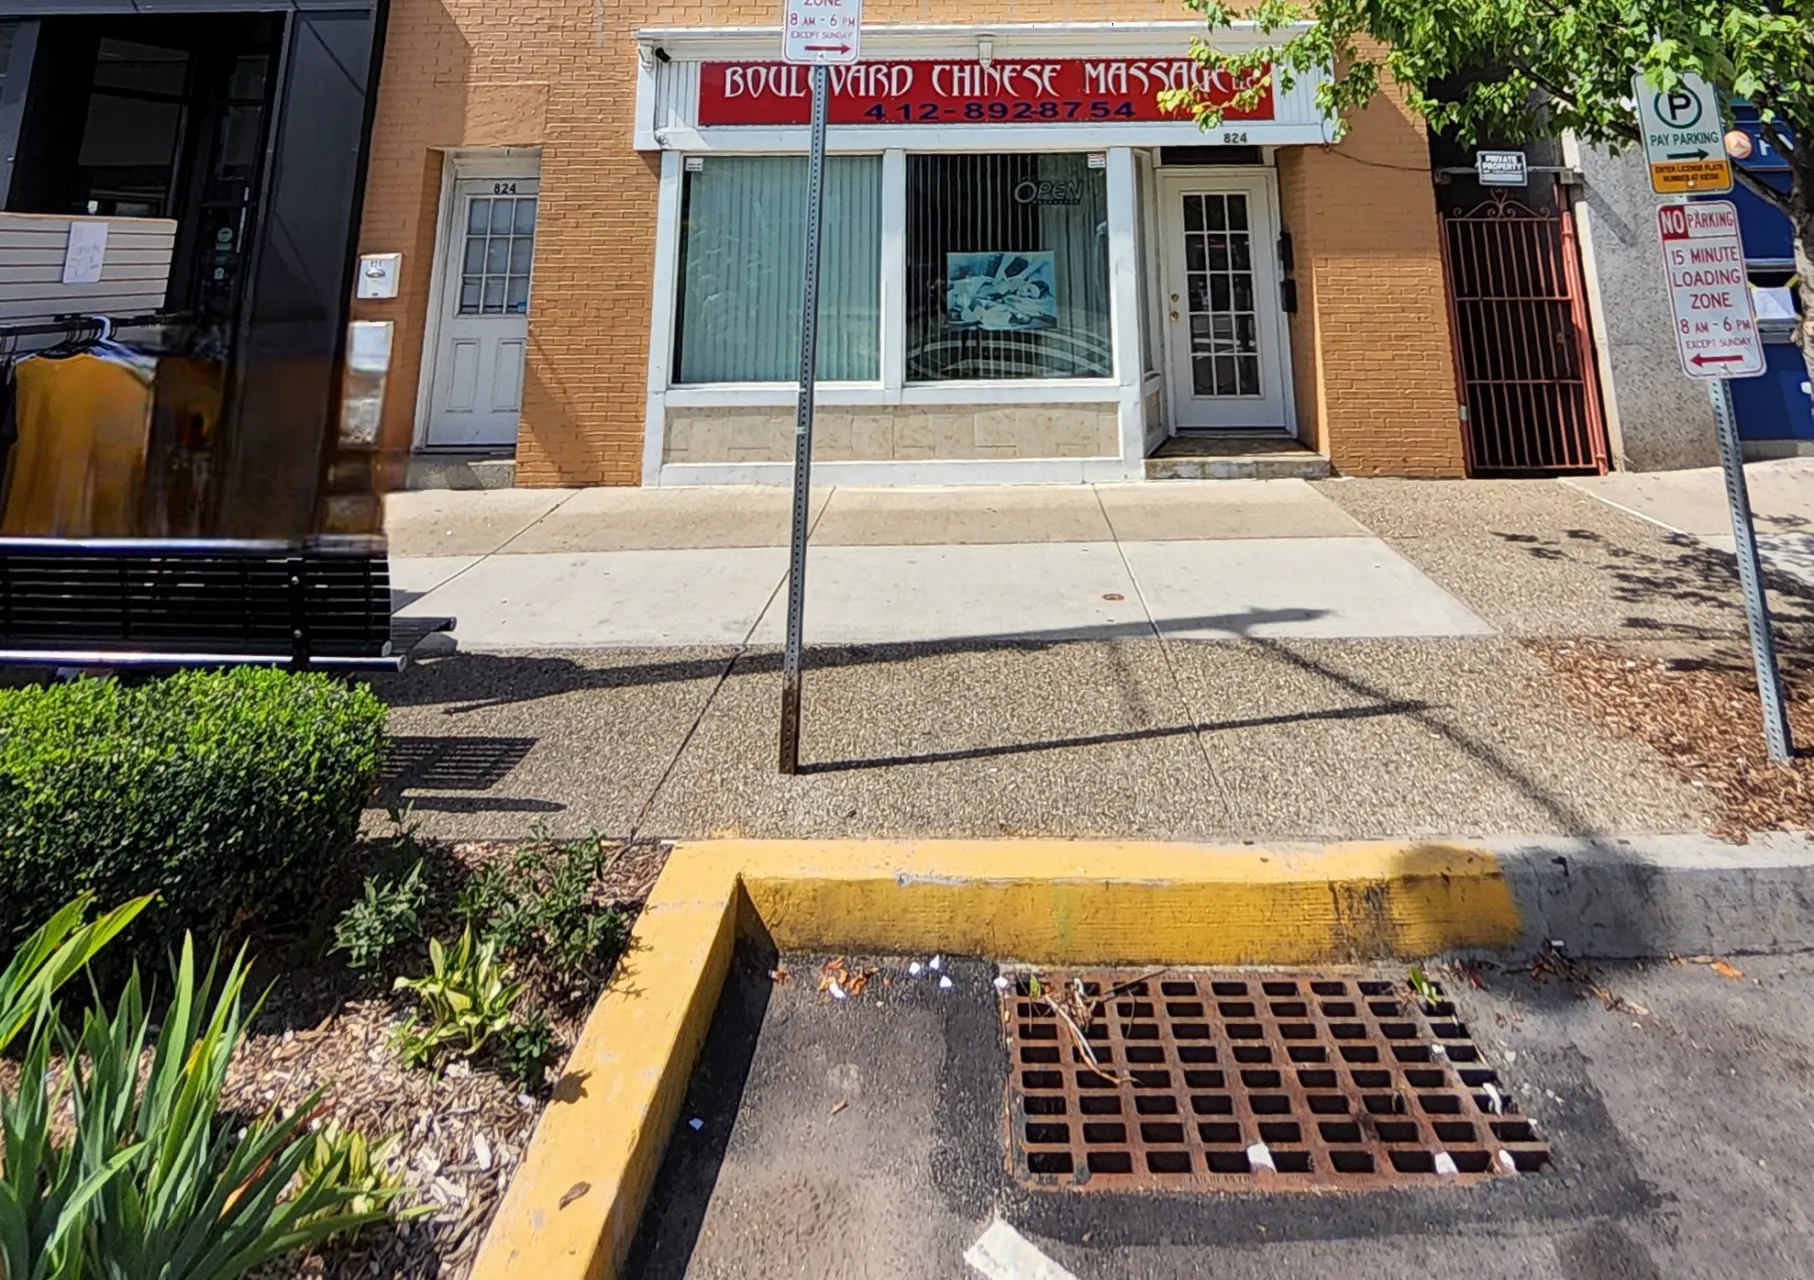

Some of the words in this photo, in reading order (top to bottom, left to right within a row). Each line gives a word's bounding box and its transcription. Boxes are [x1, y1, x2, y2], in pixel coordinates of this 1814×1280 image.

[790, 12, 798, 26] 8
[802, 16, 816, 25] AM
[830, 14, 837, 27] 6
[842, 17, 855, 26] PM
[791, 31, 819, 39] EXCEPT
[822, 31, 852, 39] SUNDAY
[932, 64, 1061, 98] CHINESE
[1667, 93, 1691, 120] P
[1223, 132, 1248, 144] 824
[1650, 134, 1669, 146] PAY
[1672, 131, 1719, 145] PARKING
[1482, 162, 1521, 170] PROPERTY
[493, 182, 516, 195] 824
[1014, 181, 1083, 203] OPEN
[1660, 210, 1684, 234] NO
[1687, 211, 1734, 228] PARKING
[1671, 249, 1685, 265] 15
[1690, 246, 1739, 264] MINUTE
[1672, 269, 1741, 287] LOADING
[1690, 292, 1733, 309] ZONE
[1680, 318, 1690, 334] 8
[1695, 321, 1709, 333] AM
[1723, 316, 1732, 332] 6
[1736, 319, 1751, 331] PM
[1685, 338, 1717, 350] EXCEPT
[1719, 336, 1752, 348] SUNDAY
